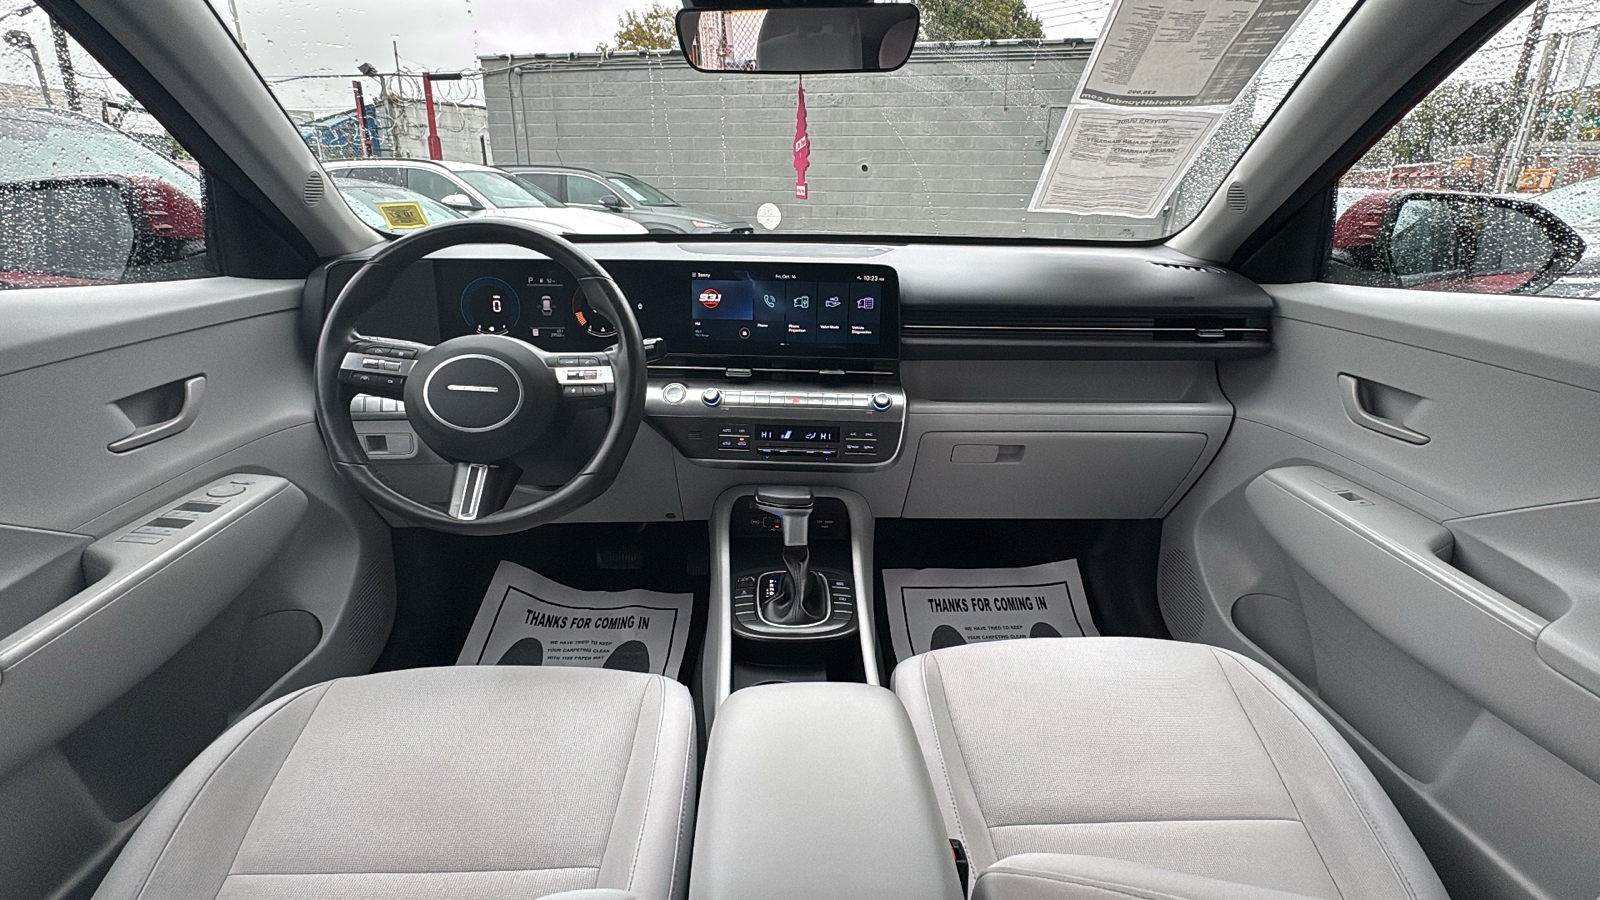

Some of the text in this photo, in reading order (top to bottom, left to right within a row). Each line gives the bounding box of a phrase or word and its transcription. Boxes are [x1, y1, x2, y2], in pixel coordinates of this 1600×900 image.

[492, 300, 501, 312] 0
[928, 596, 1048, 612] THANKS FOR COMING IN
[524, 609, 650, 630] THANKS FOR COMING IN
